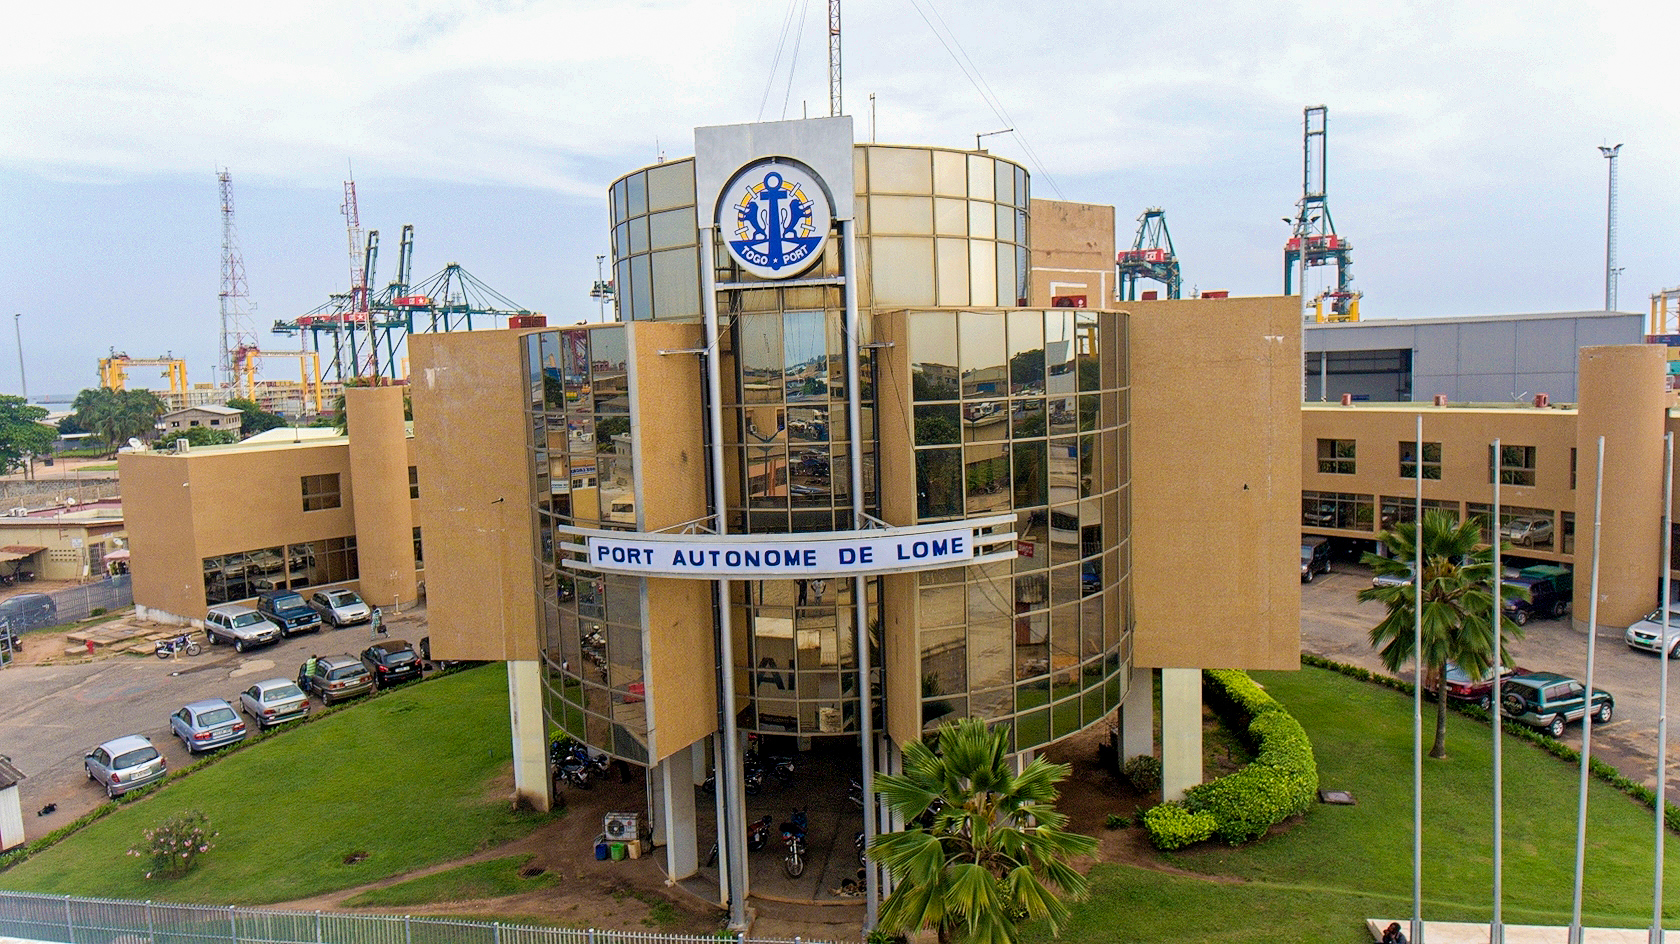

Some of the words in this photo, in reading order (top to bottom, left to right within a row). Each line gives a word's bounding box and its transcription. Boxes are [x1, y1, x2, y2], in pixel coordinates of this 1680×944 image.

[741, 246, 768, 265] TOGO
[783, 245, 808, 265] PORT
[597, 546, 654, 565] PORT
[672, 550, 817, 567] AUTONOME
[838, 546, 873, 565] DE
[897, 537, 964, 560] LOME
